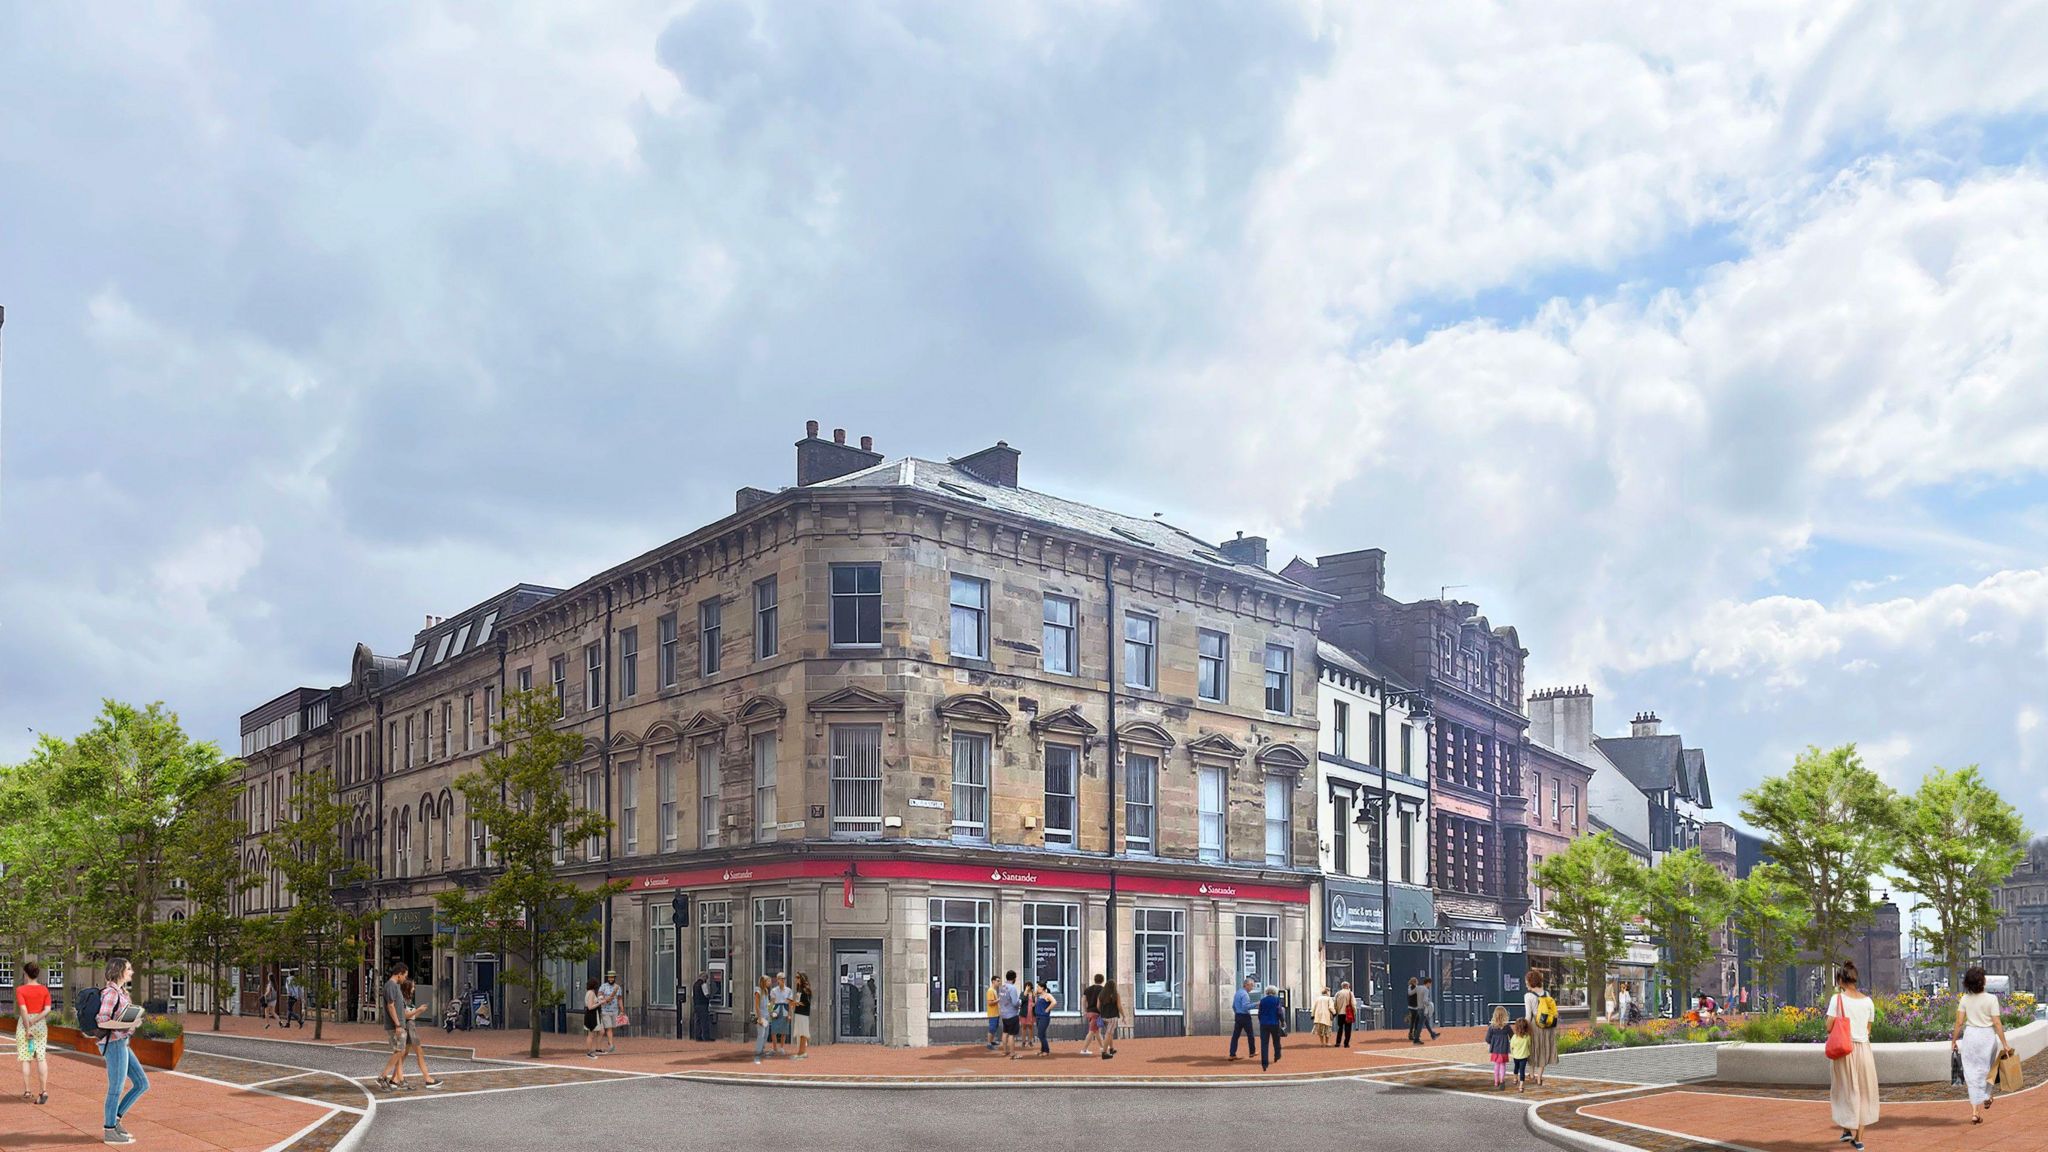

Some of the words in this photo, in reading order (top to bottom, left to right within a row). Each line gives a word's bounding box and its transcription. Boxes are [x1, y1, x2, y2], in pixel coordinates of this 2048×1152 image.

[730, 869, 753, 880] Santander
[1002, 871, 1037, 882] Santander
[650, 877, 669, 886] Santander
[1208, 885, 1236, 895] Santander
[1467, 931, 1497, 943] MEANTIME
